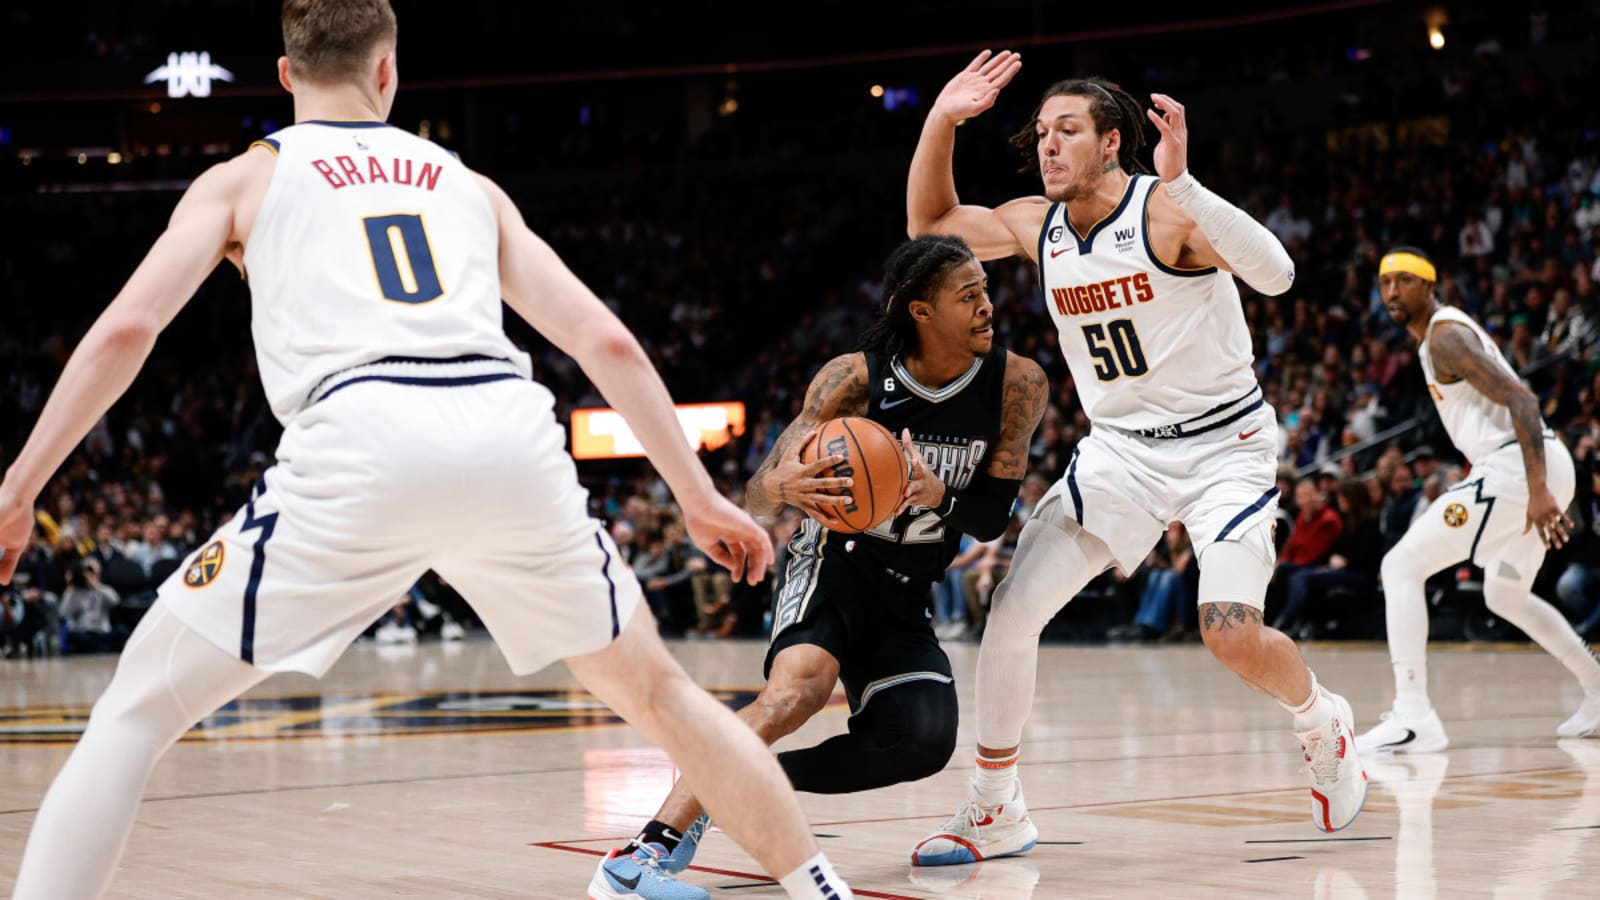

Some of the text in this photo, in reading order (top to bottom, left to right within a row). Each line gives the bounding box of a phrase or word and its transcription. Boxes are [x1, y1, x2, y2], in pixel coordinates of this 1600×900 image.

[311, 155, 443, 191] BRAUN
[1114, 226, 1135, 242] WU
[360, 211, 446, 305] 0
[1051, 272, 1154, 316] NUGGETS
[1080, 318, 1149, 382] 50
[884, 377, 895, 392] 6
